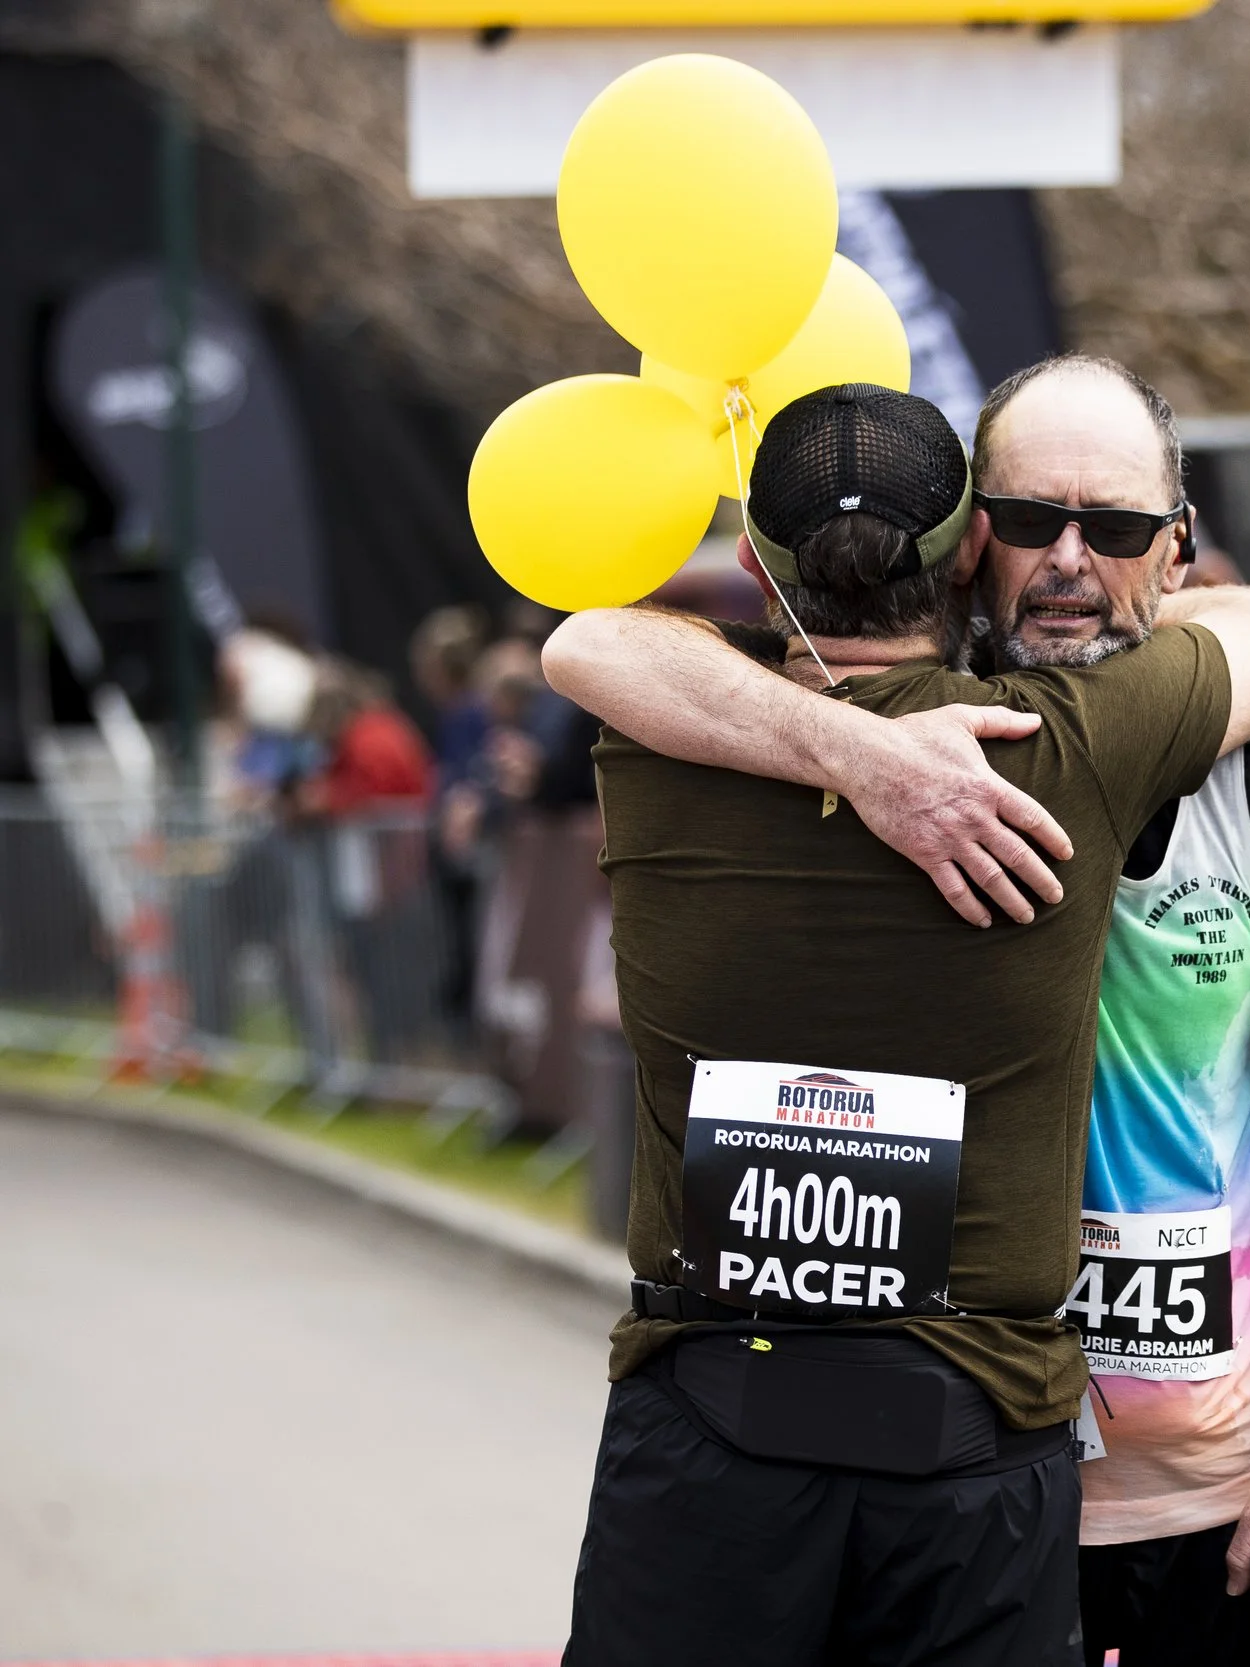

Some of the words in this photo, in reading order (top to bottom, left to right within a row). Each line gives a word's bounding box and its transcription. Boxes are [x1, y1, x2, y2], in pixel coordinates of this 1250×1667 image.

[1145, 877, 1200, 930] THAMES
[1183, 907, 1234, 926] ROUND
[1196, 930, 1227, 944] THE
[1170, 949, 1245, 967] MOUNTAIN
[1195, 969, 1227, 984] 1989
[777, 1085, 875, 1114] ROTORUA
[776, 1107, 875, 1129] MARATHON
[714, 1129, 812, 1152] ROTORUA
[816, 1138, 930, 1163] MARATHON
[729, 1167, 901, 1250] 4h00m
[1081, 1226, 1120, 1242] TORUA
[1081, 1239, 1120, 1250] RATHON
[1158, 1226, 1207, 1248] NZCT
[719, 1250, 905, 1308] PACER
[1066, 1261, 1206, 1335] 445
[1080, 1334, 1122, 1353] URIE
[1125, 1338, 1213, 1357] ABRAHAM
[1087, 1356, 1126, 1370] ORUA
[1130, 1361, 1207, 1374] MARATHON
